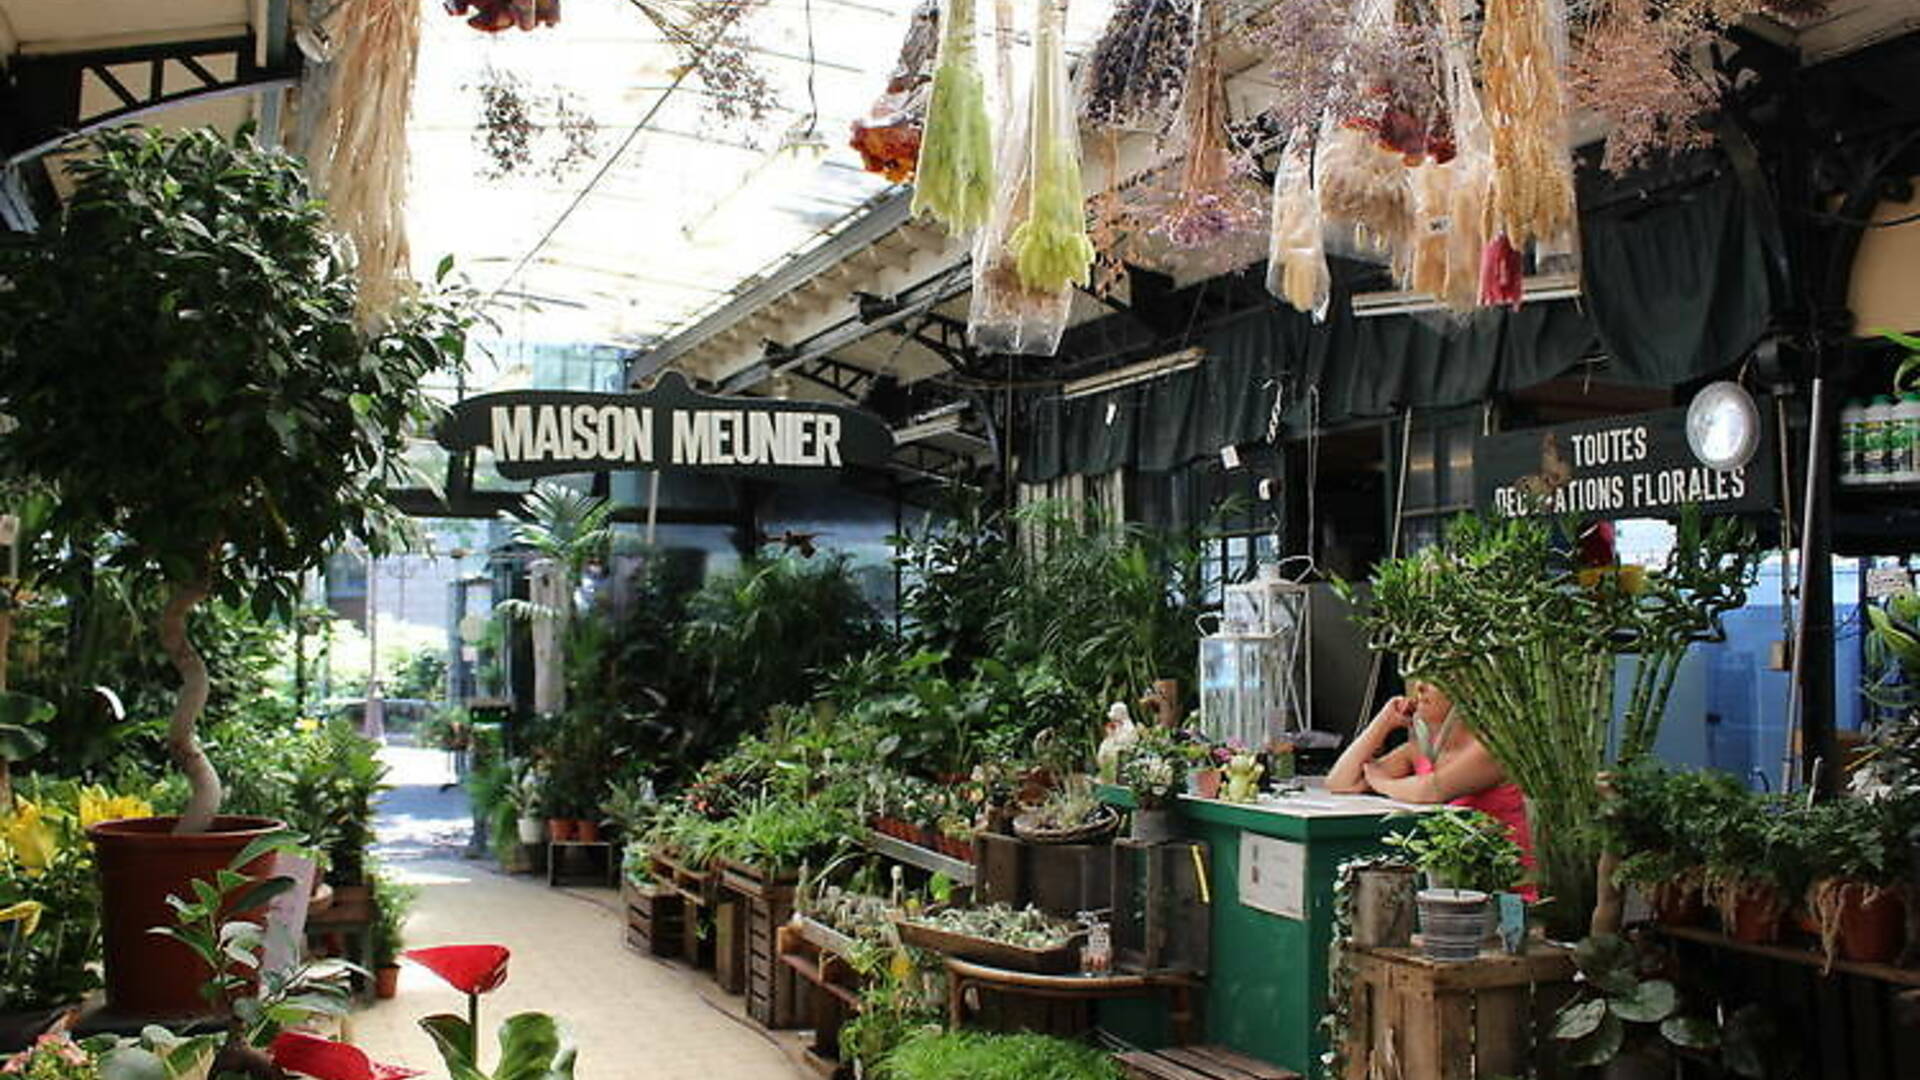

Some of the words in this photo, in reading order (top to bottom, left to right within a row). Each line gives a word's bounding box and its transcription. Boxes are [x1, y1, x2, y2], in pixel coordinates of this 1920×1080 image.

[491, 405, 653, 463] MAISON
[672, 409, 842, 467] MEUNIER
[1571, 426, 1648, 466] TOUTES
[1494, 476, 1624, 518] DECATIONS
[1632, 465, 1746, 507] FLORALES
